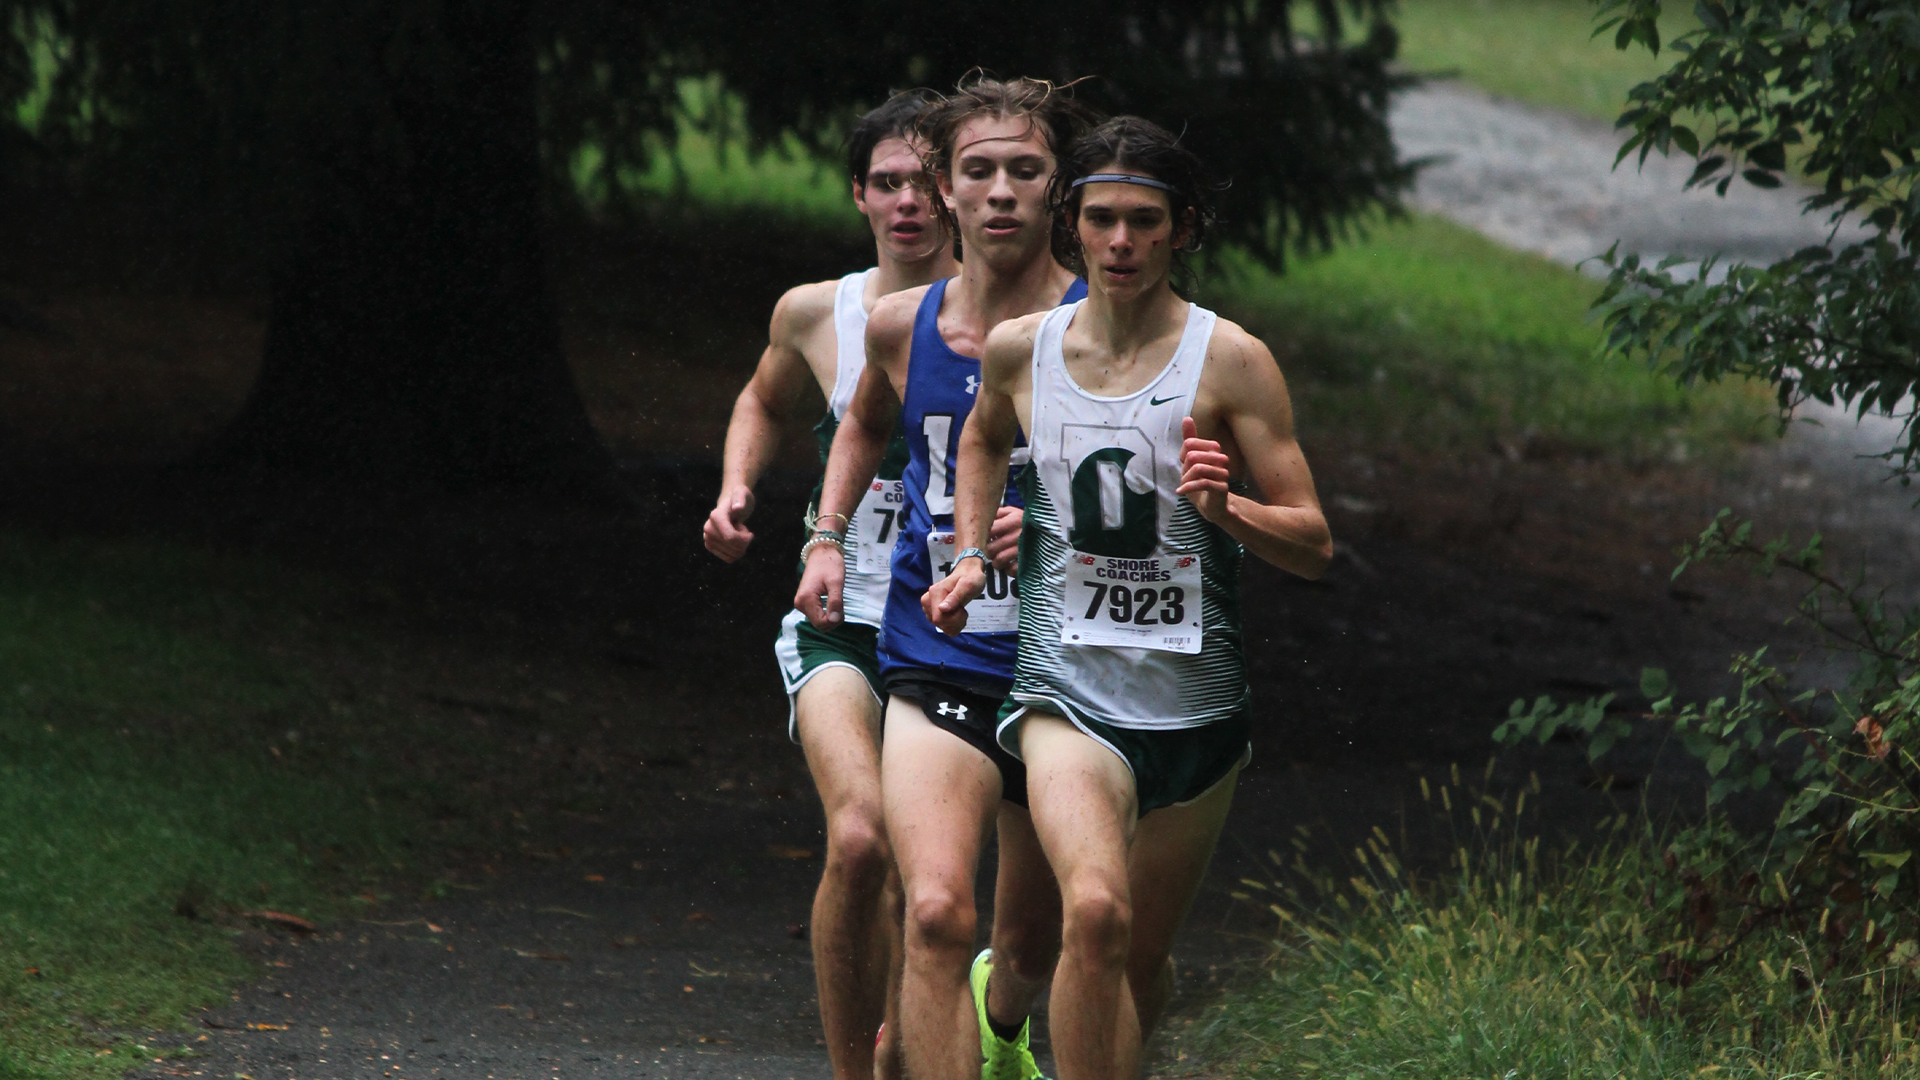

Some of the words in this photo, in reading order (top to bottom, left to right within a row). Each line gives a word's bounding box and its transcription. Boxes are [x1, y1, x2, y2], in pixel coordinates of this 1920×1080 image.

[1107, 558, 1160, 572] SHORE
[1096, 567, 1171, 583] COACHES
[1083, 580, 1185, 626] 7923
